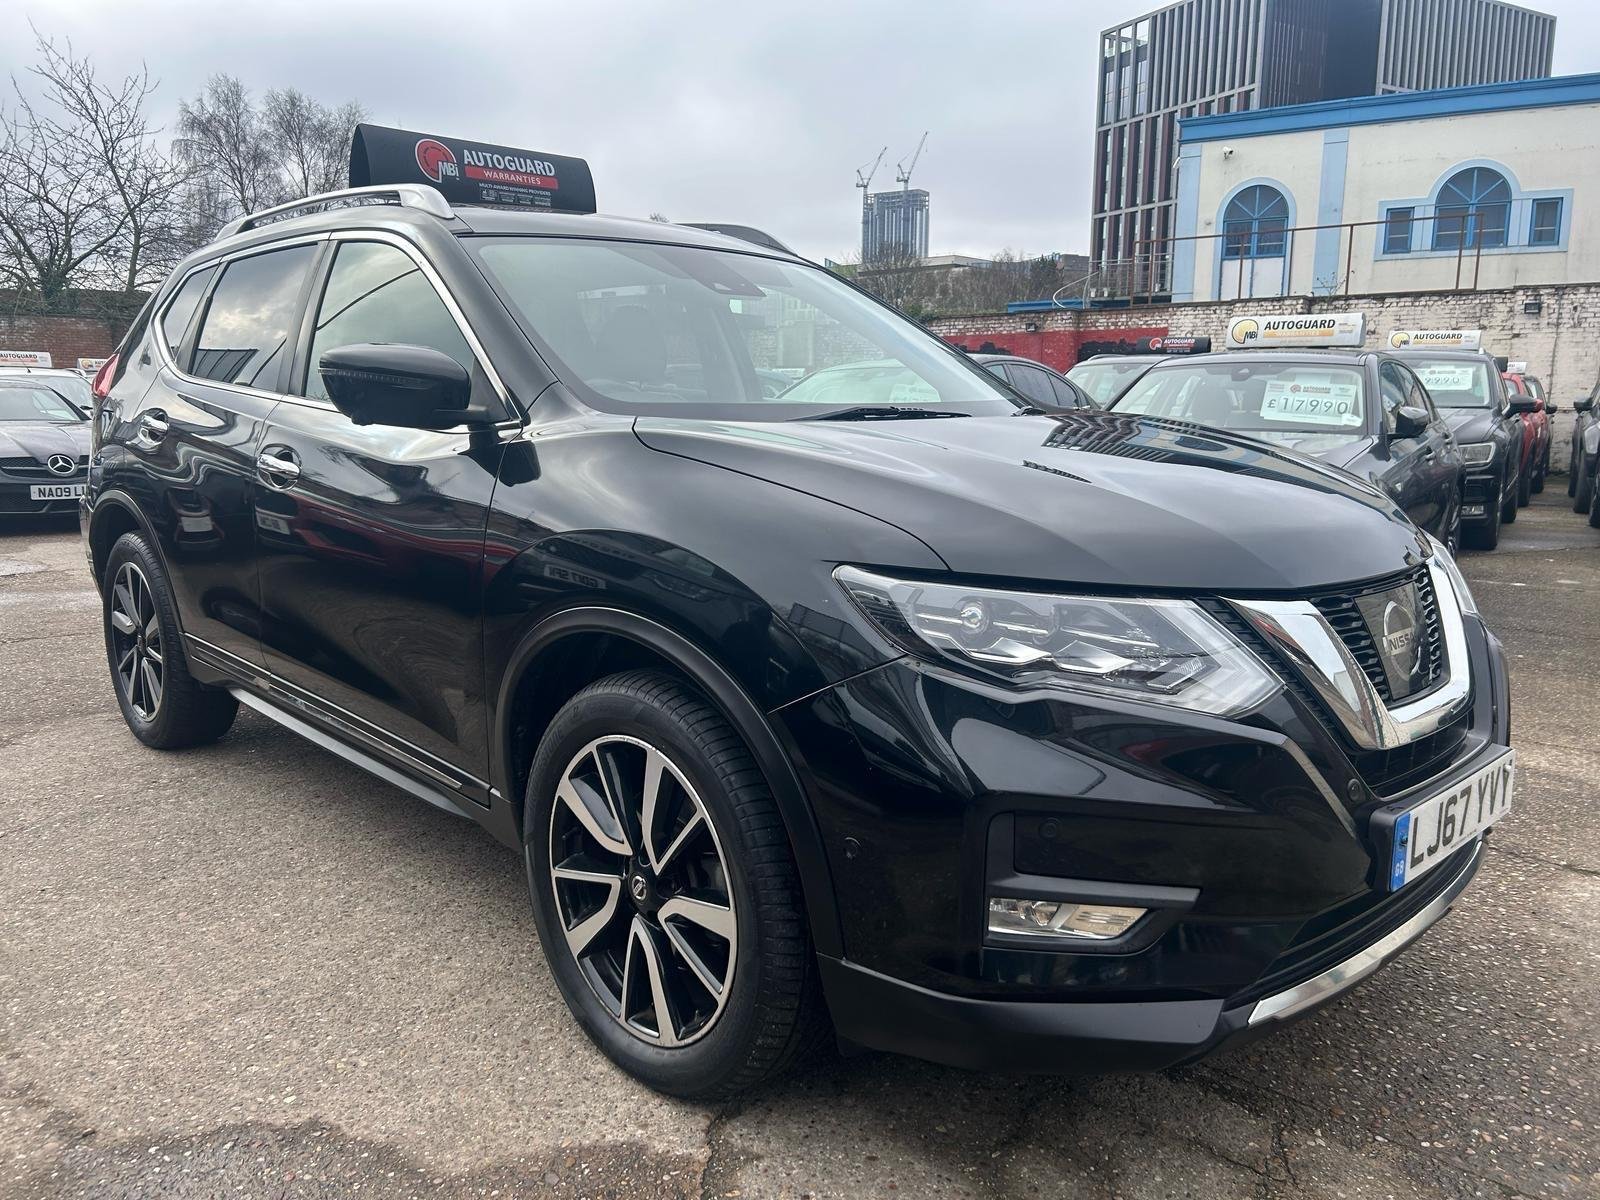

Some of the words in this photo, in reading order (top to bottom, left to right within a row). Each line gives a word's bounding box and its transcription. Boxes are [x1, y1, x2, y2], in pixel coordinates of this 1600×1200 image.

[463, 149, 556, 176] AUTOGUARD
[483, 170, 541, 185] WARRANTIES
[1264, 319, 1336, 331] AUTOGUARD
[38, 486, 71, 498] NA09
[1410, 785, 1472, 869] LJ67
[1477, 759, 1513, 824] YVY
